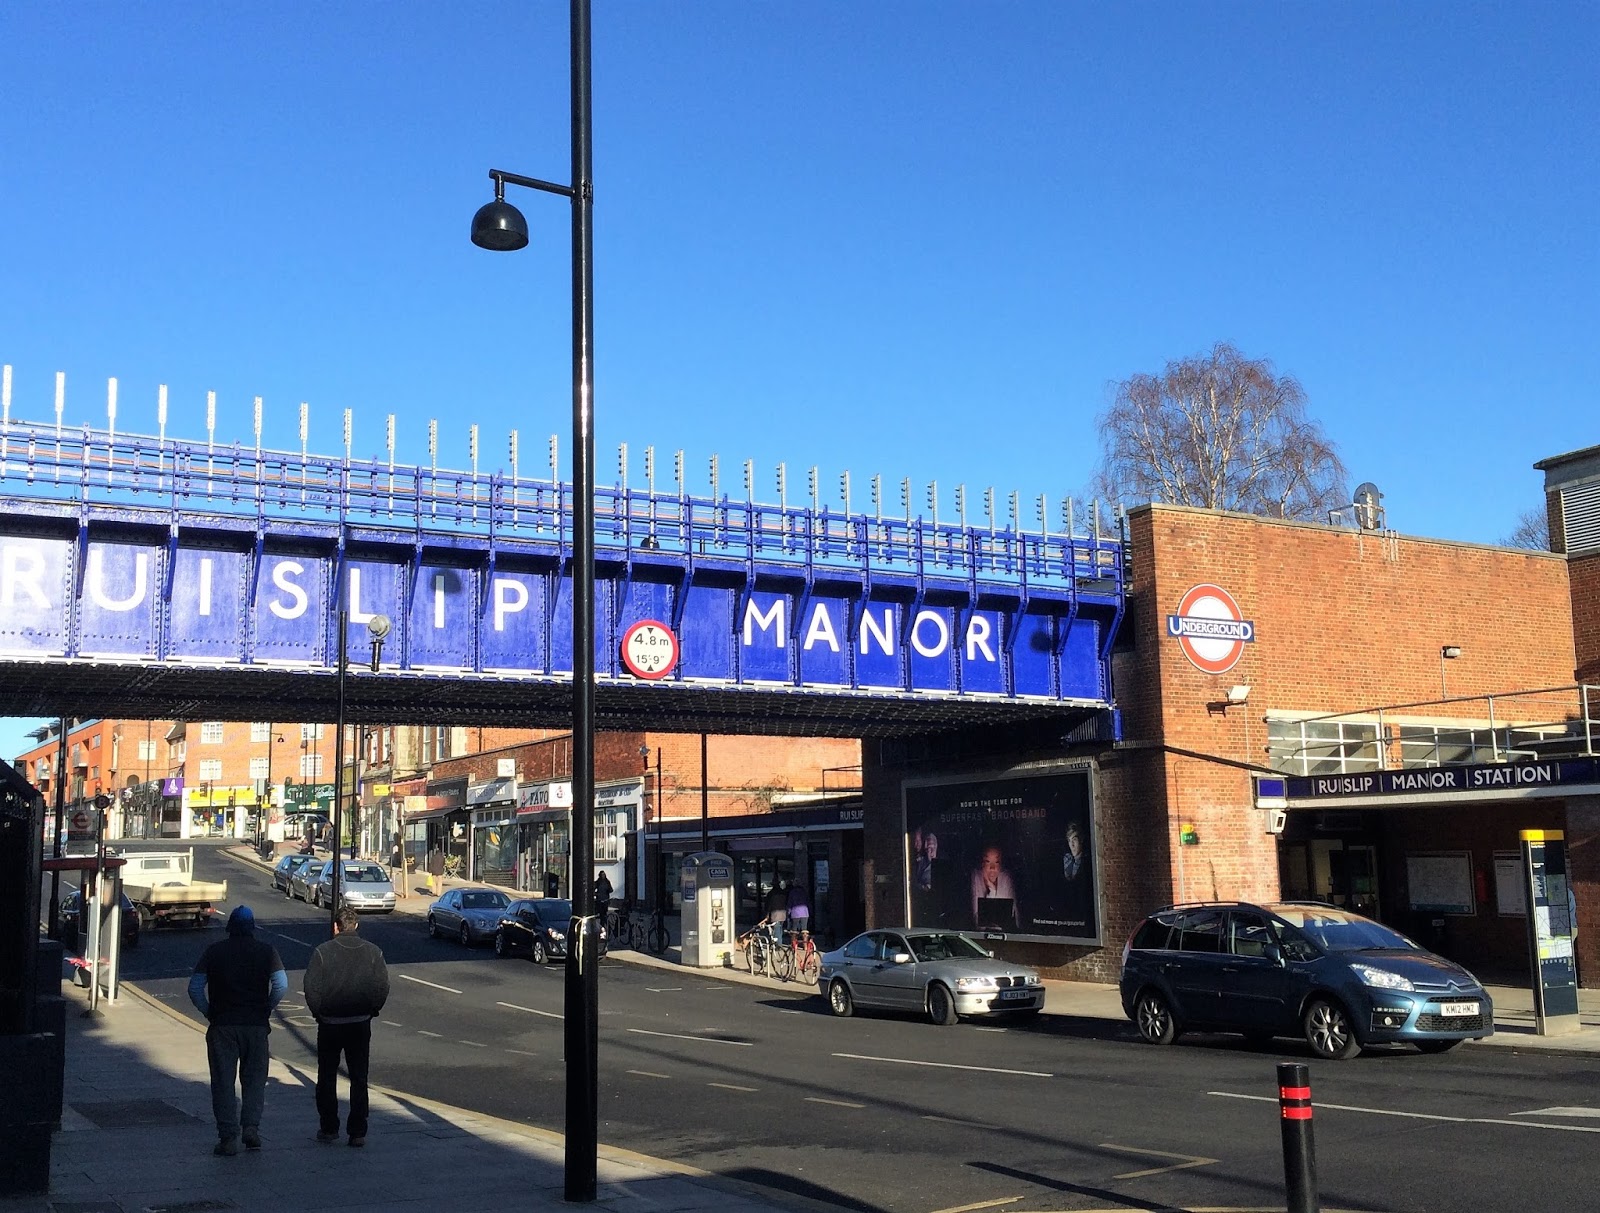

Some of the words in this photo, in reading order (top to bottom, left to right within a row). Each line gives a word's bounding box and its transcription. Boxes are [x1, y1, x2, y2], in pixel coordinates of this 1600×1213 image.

[3, 546, 529, 631] RUISLIP
[744, 599, 996, 662] MANOR
[1169, 617, 1252, 640] UNDERGROUND
[634, 633, 656, 645] 4.8
[1318, 777, 1373, 794] RUISLIP
[1392, 771, 1456, 790] MANOR
[1474, 765, 1551, 785] STATION
[530, 791, 548, 805] FAVO
[840, 810, 864, 820] RUISLIP
[991, 808, 1047, 820] BROADBAND
